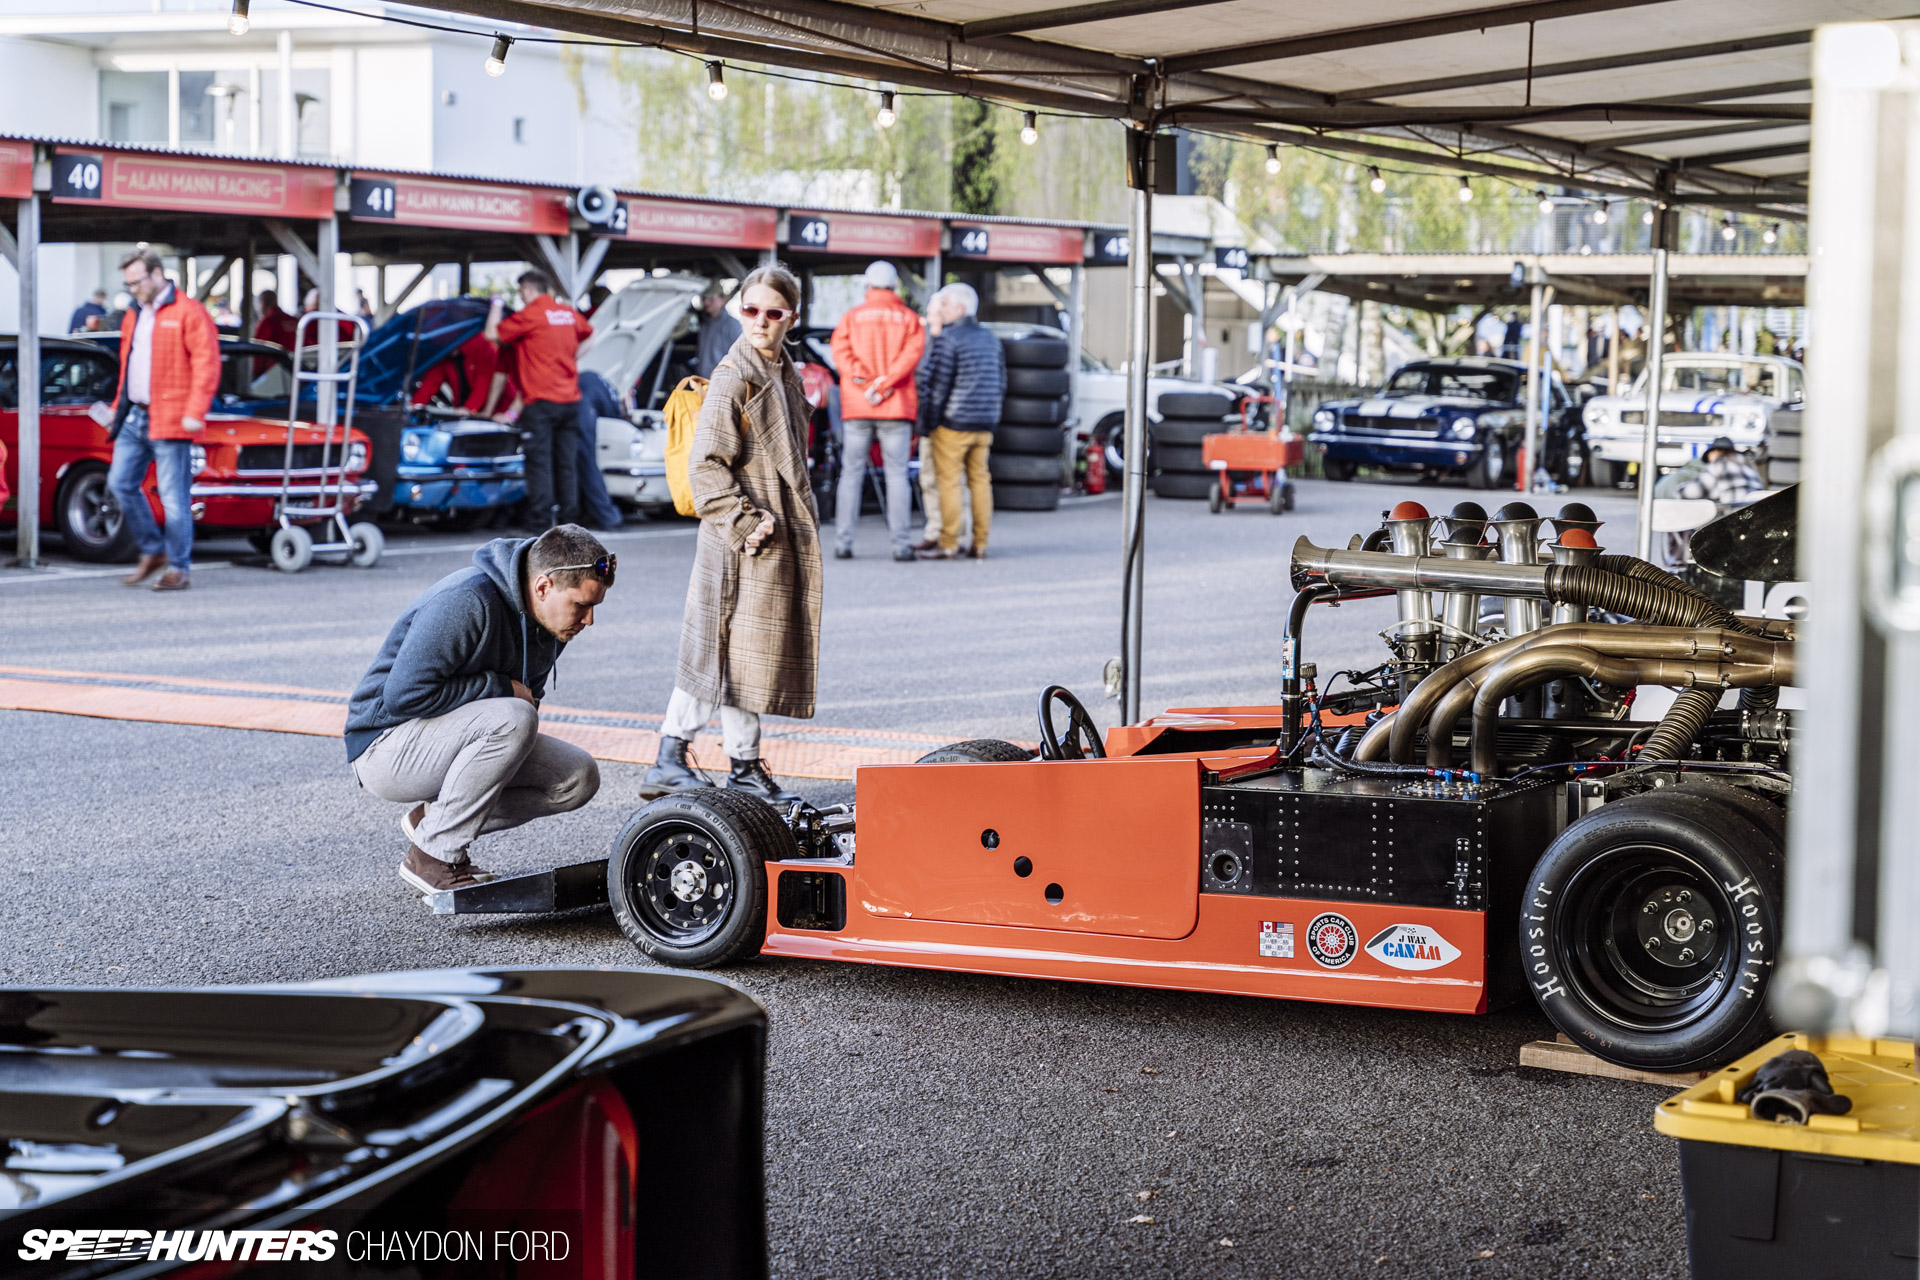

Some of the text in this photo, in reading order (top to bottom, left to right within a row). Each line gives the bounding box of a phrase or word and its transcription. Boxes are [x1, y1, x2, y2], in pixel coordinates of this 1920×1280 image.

[67, 163, 100, 190] 40
[128, 170, 272, 199] ALAN MANN RACING
[365, 187, 393, 212] 41
[801, 221, 828, 243] 43
[961, 231, 988, 251] 44
[1104, 237, 1130, 257] 45
[1223, 249, 1248, 268] 46
[1310, 917, 1355, 946] SPORTS CAR CLUB
[1399, 935, 1427, 945] J WAX
[1523, 881, 1566, 1001] Hoosier
[1725, 876, 1773, 998] Hoosier
[1312, 946, 1351, 965] OF AMERICA
